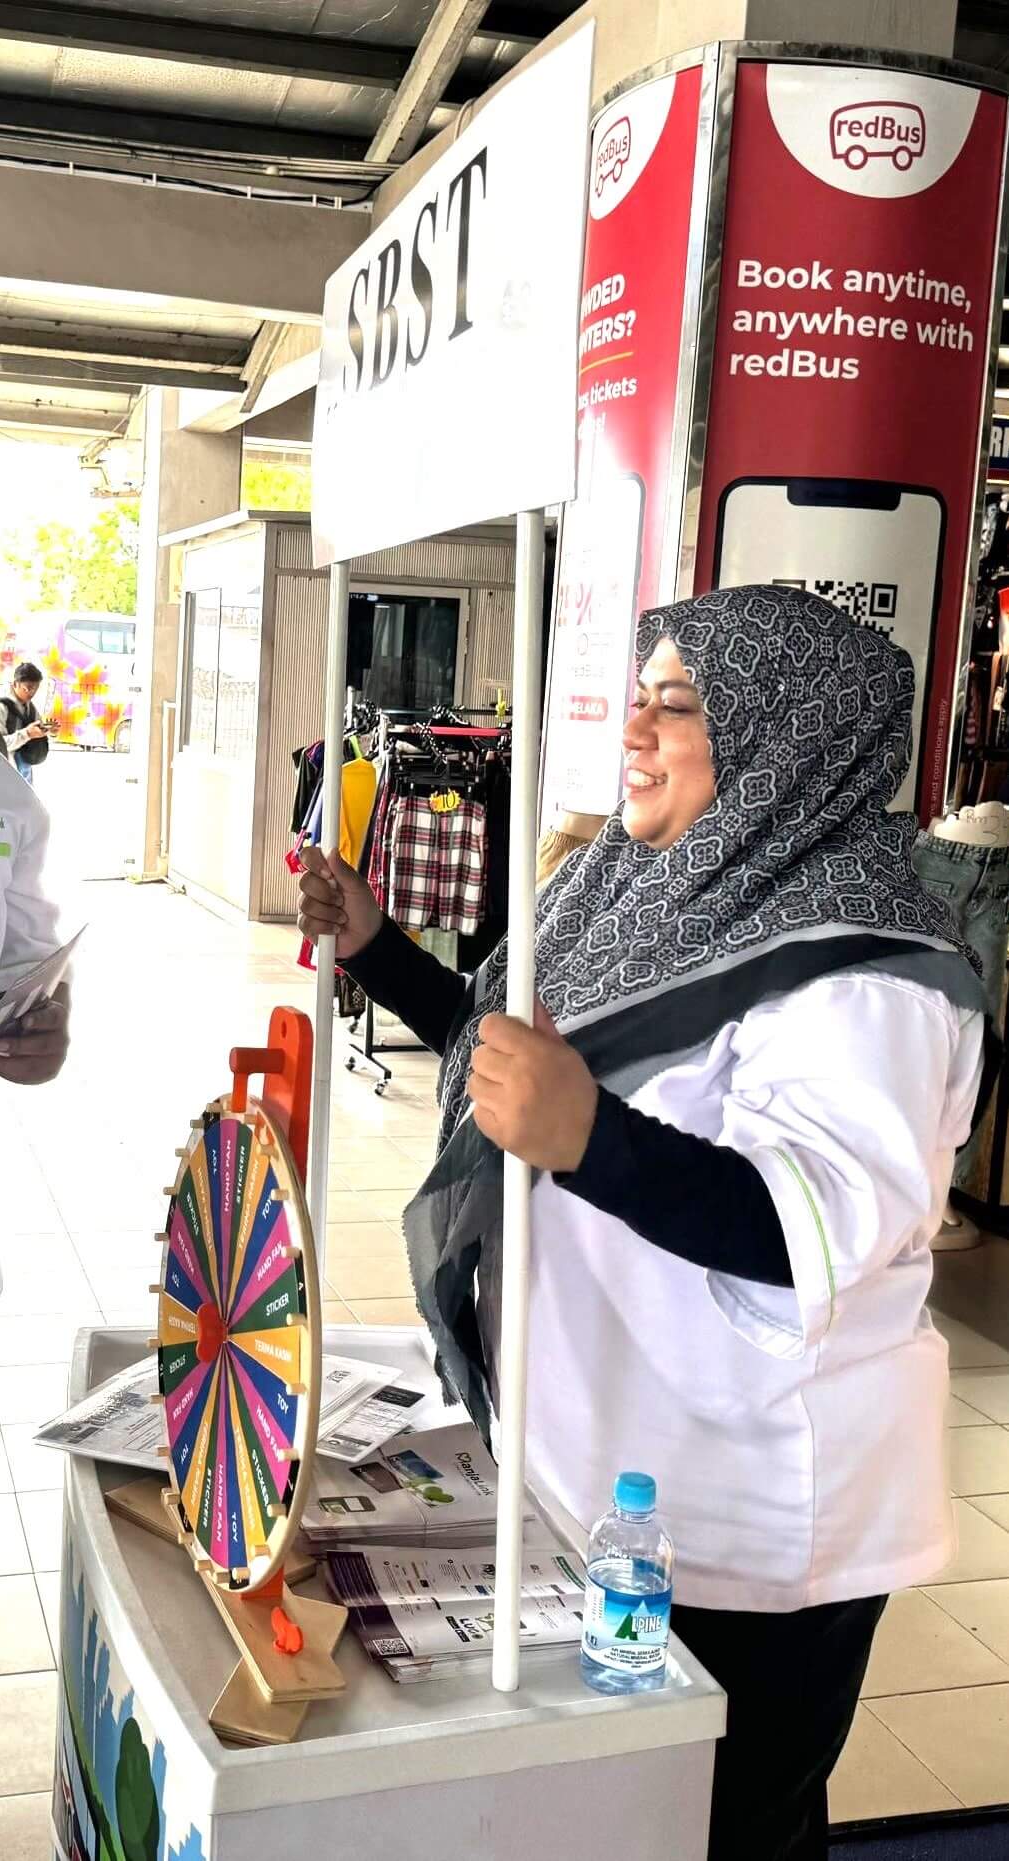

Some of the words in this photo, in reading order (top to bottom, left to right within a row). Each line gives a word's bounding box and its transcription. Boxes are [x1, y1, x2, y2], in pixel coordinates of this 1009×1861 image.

[836, 115, 921, 144] redBus
[343, 145, 488, 393] SBST
[737, 259, 833, 291] Book
[842, 269, 972, 314] anytime,
[579, 309, 637, 359] NTERS?
[732, 306, 908, 341] anywhere
[916, 318, 974, 352] with
[729, 348, 861, 380] redBus
[589, 377, 638, 407] tickets
[257, 1255, 272, 1281] HAND
[265, 1292, 290, 1317] STICKER
[254, 1338, 275, 1356] TERIMA
[276, 1393, 289, 1415] TOY
[257, 1403, 272, 1439] HAND
[252, 1448, 270, 1507] STICKER
[216, 1511, 224, 1543] FAN
[231, 1512, 239, 1543] TOY
